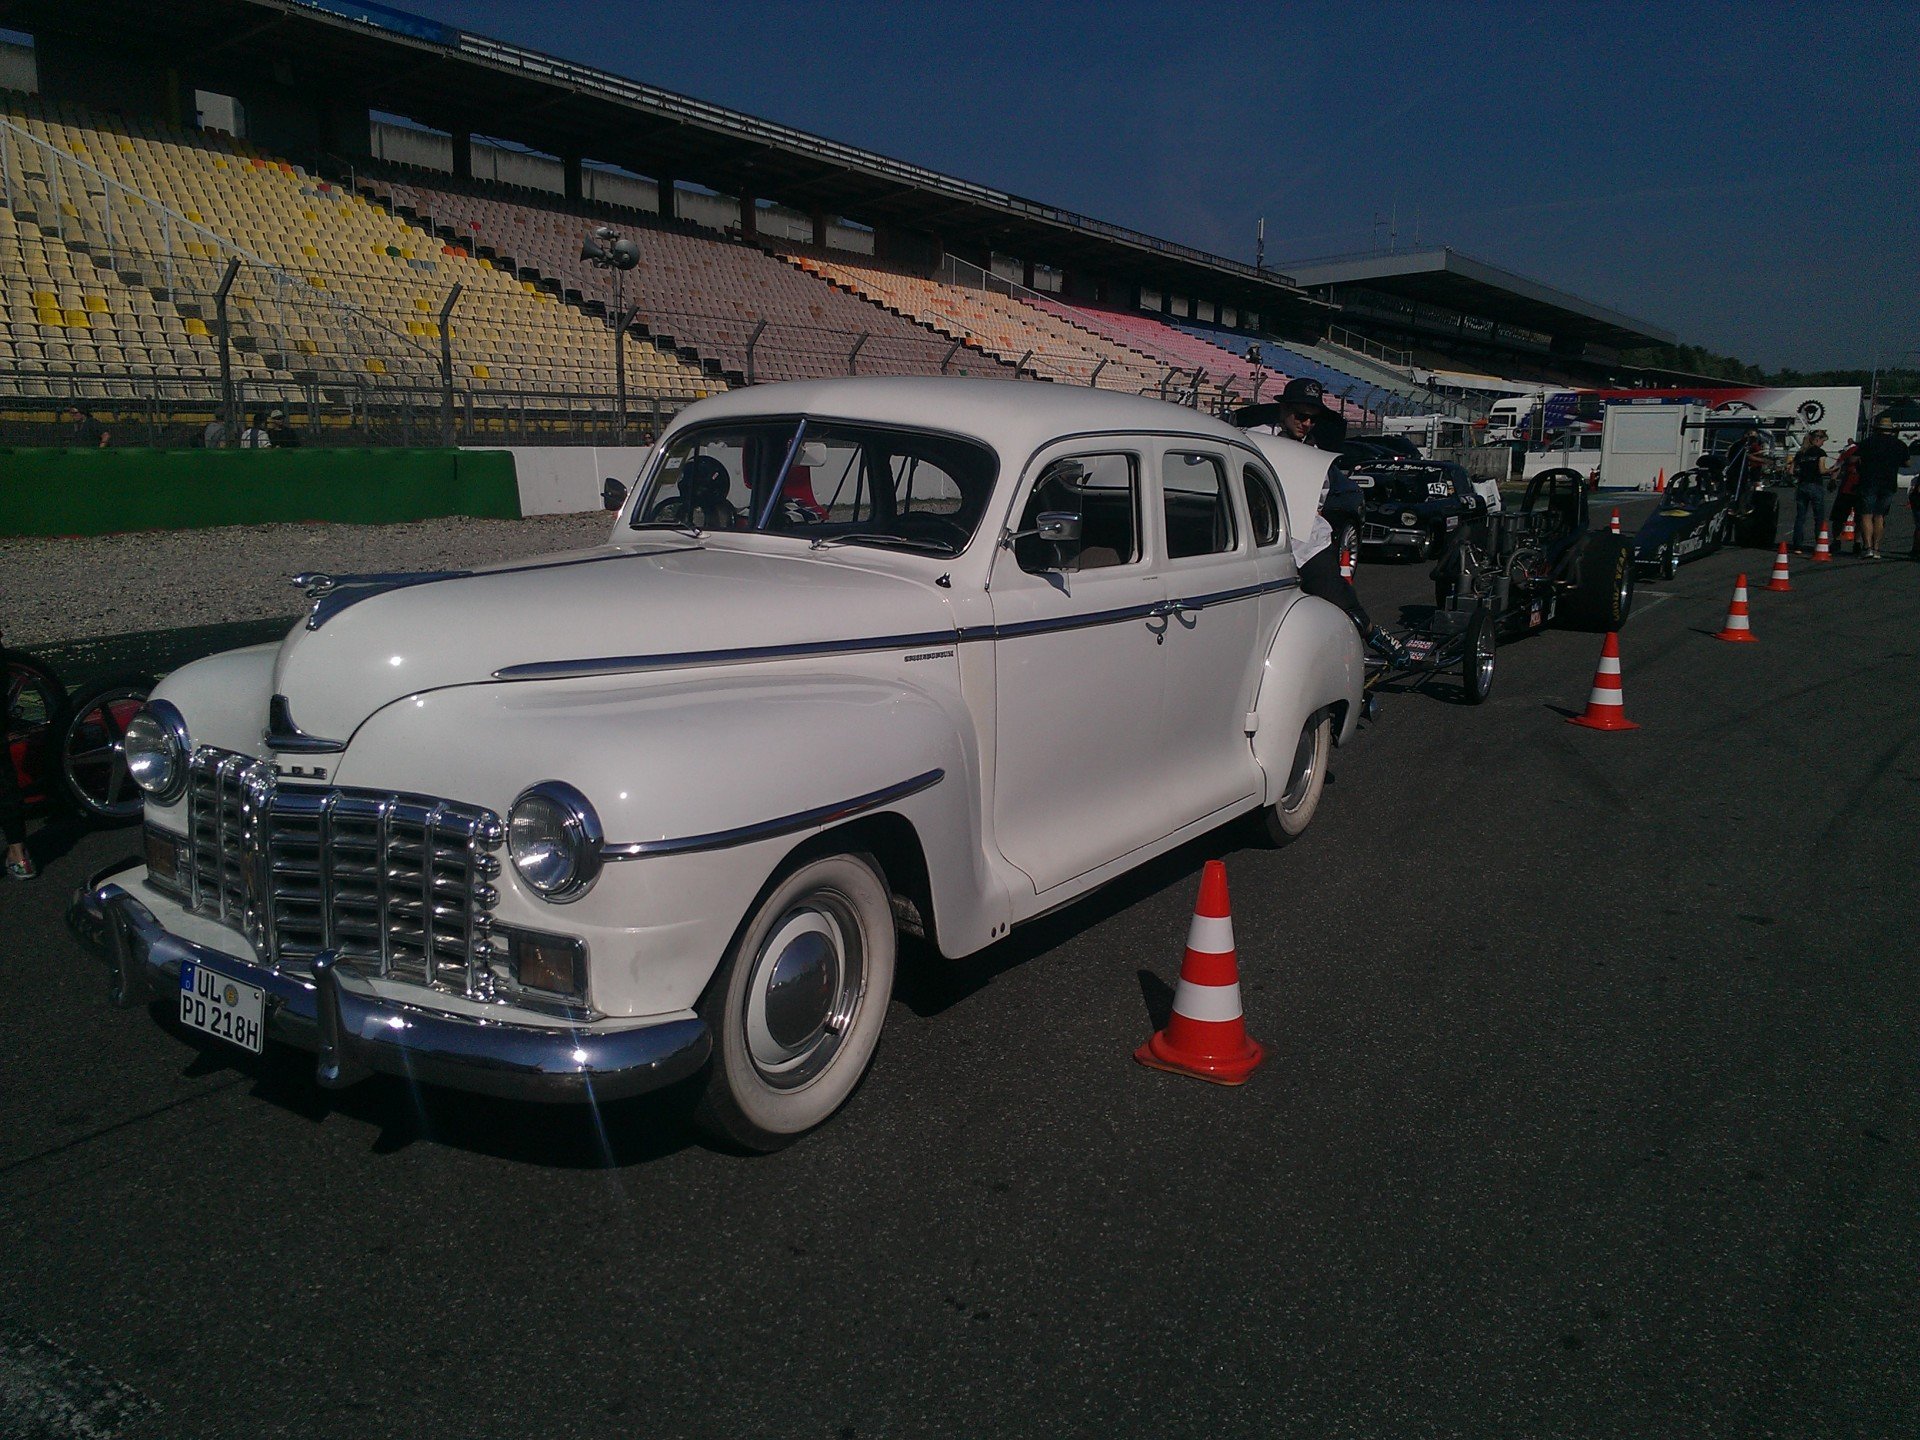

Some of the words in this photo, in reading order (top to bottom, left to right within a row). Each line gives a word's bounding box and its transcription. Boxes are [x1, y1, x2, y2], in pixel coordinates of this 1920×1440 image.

[1429, 482, 1446, 495] 457
[198, 969, 222, 1004] UL
[183, 995, 206, 1027] PD
[210, 1006, 259, 1050] 218H
